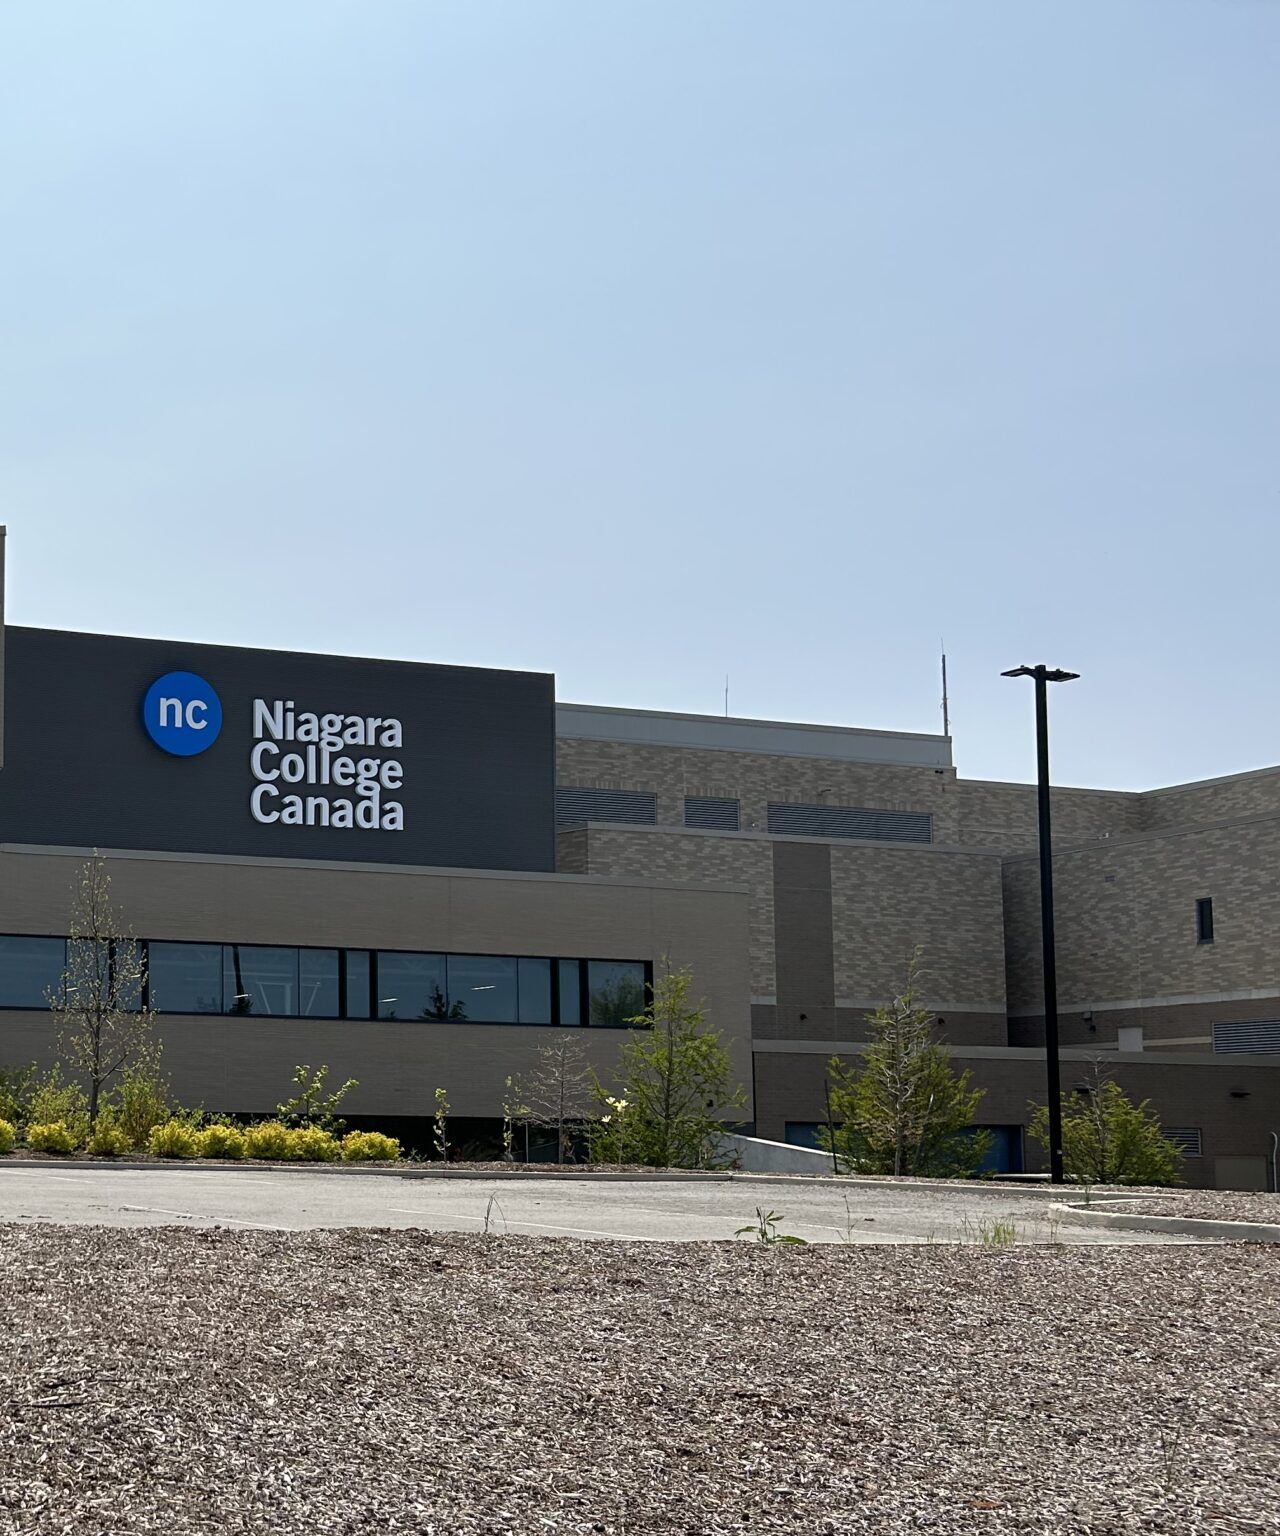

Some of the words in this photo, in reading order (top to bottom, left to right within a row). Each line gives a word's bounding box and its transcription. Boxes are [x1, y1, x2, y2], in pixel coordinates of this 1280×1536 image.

[159, 697, 208, 730] nc
[252, 698, 403, 752] Niagara
[250, 741, 404, 796] College
[250, 783, 404, 831] Canada
